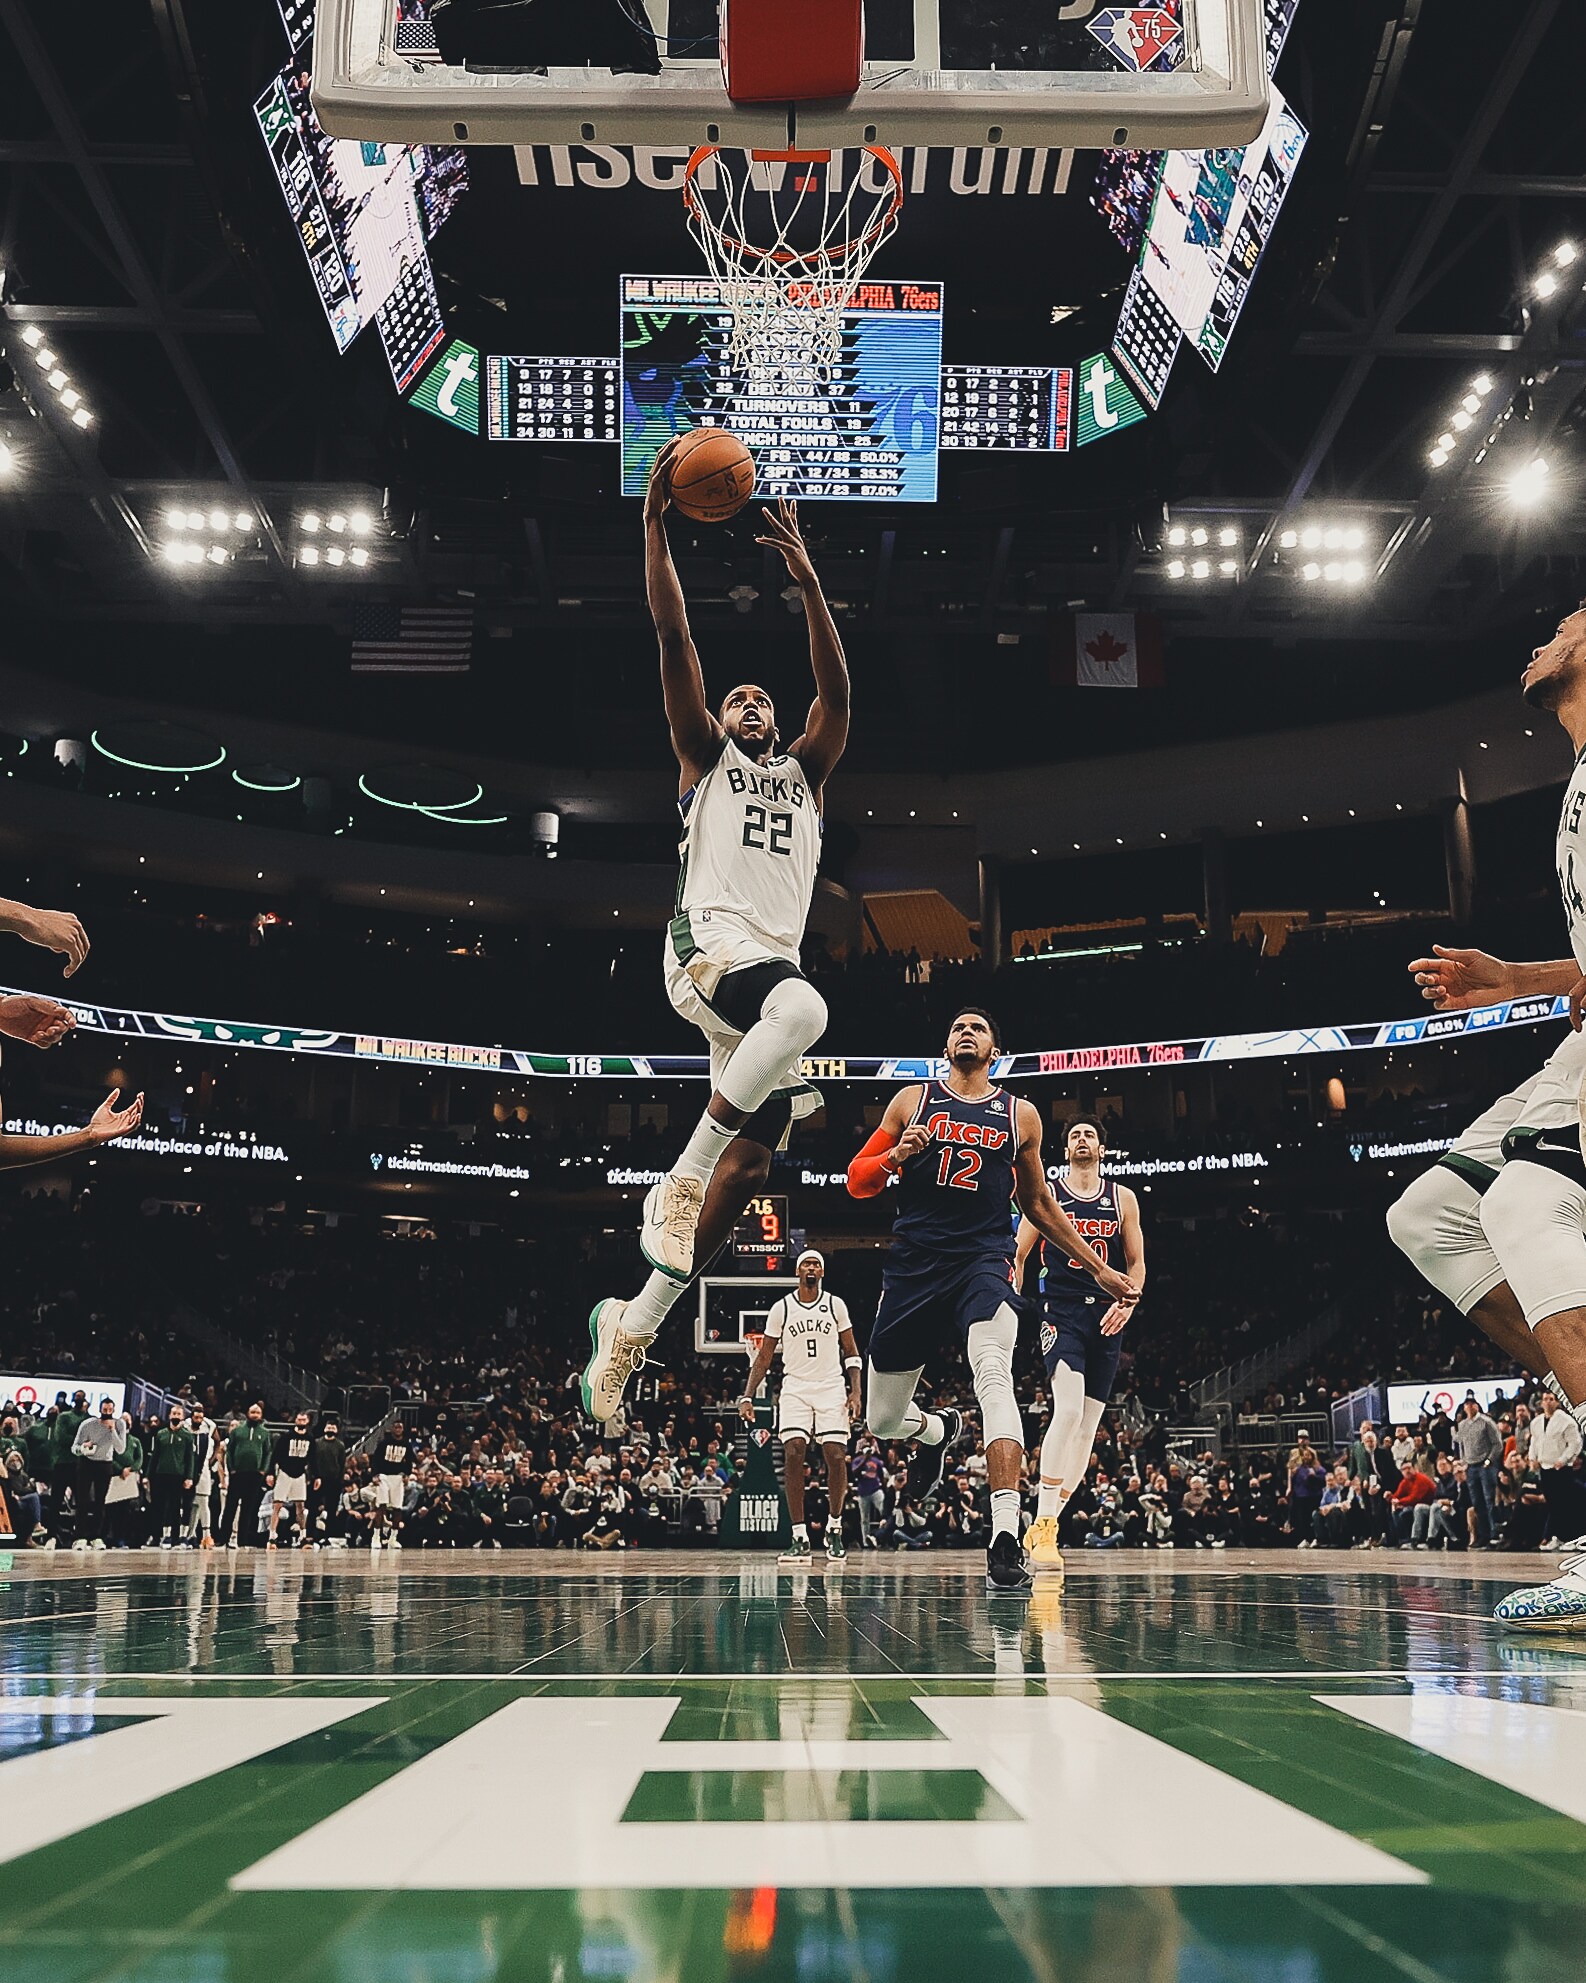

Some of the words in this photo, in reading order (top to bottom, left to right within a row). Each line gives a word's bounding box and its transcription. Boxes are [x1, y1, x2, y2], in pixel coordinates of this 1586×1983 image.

[1142, 19, 1161, 38] 75
[1251, 171, 1274, 215] 120
[323, 252, 345, 293] 120
[901, 286, 939, 310] 76ers
[539, 369, 553, 380] 17
[563, 369, 571, 380] 7
[584, 370, 593, 380] 2
[604, 370, 614, 380] 4
[720, 366, 730, 377] 11
[518, 383, 532, 394] 13
[584, 384, 593, 395] 0
[828, 385, 846, 396] 37
[947, 378, 957, 388] 0
[966, 378, 979, 389] 17
[989, 379, 998, 389] 2
[1010, 379, 1019, 390] 4
[1032, 380, 1038, 390] 1
[518, 398, 532, 409] 21
[538, 398, 554, 409] 24
[562, 399, 572, 409] 4
[703, 398, 713, 410] 7
[732, 400, 830, 413] TURNOVERS
[849, 402, 860, 413] 11
[945, 392, 959, 403] 12
[1009, 394, 1018, 404] 4
[1032, 394, 1038, 405] 1
[517, 413, 534, 423] 22
[539, 413, 553, 423] 17
[563, 414, 572, 424] 5
[584, 414, 593, 424] 2
[605, 414, 614, 425] 2
[942, 407, 959, 417] 20
[965, 407, 978, 417] 17
[1009, 408, 1018, 419] 2
[1029, 408, 1038, 419] 4
[730, 416, 780, 429] TOTAL
[781, 417, 833, 430] FOULS
[944, 421, 957, 432] 21
[962, 421, 979, 432] 42
[985, 422, 999, 433] 14
[1008, 423, 1017, 433] 5
[1029, 422, 1038, 433] 4
[517, 427, 534, 437] 34
[538, 427, 555, 438] 30
[562, 428, 573, 438] 11
[780, 434, 838, 447] POINTS
[942, 436, 958, 446] 30
[964, 436, 977, 446] 13
[987, 436, 996, 447] 7
[1010, 437, 1016, 447] 1
[1028, 437, 1037, 448] 2
[764, 467, 796, 479] 3PT
[770, 484, 790, 496] FT
[726, 768, 804, 808] BUCKS
[743, 805, 792, 855] 22
[119, 1017, 125, 1028] 1
[355, 1037, 446, 1064] MILWAUKEE
[448, 1046, 501, 1069] BUCKS
[1039, 1046, 1142, 1073] PHILADELPHIA
[1147, 1045, 1184, 1062] 76ers
[567, 1058, 602, 1075] 116
[800, 1060, 846, 1077] 4TH
[925, 1060, 950, 1077] 12
[5, 1119, 23, 1133] at
[25, 1120, 51, 1136] the
[928, 1113, 1008, 1149] Sixers
[108, 1136, 202, 1155] Marketplace
[204, 1142, 222, 1156] of
[223, 1143, 249, 1158] the
[251, 1145, 289, 1162] NBA.
[387, 1156, 530, 1180] ticketmaster.com/Bucks
[936, 1146, 982, 1191] 12
[1100, 1159, 1185, 1176] Marketplace
[1188, 1155, 1205, 1170] of
[1205, 1154, 1229, 1170] the
[1231, 1152, 1269, 1168] NBA.
[801, 1171, 828, 1186] Buy
[830, 1174, 848, 1184] an
[762, 1214, 779, 1240] 9
[788, 1320, 832, 1337] BUCKS
[807, 1339, 817, 1357] 9
